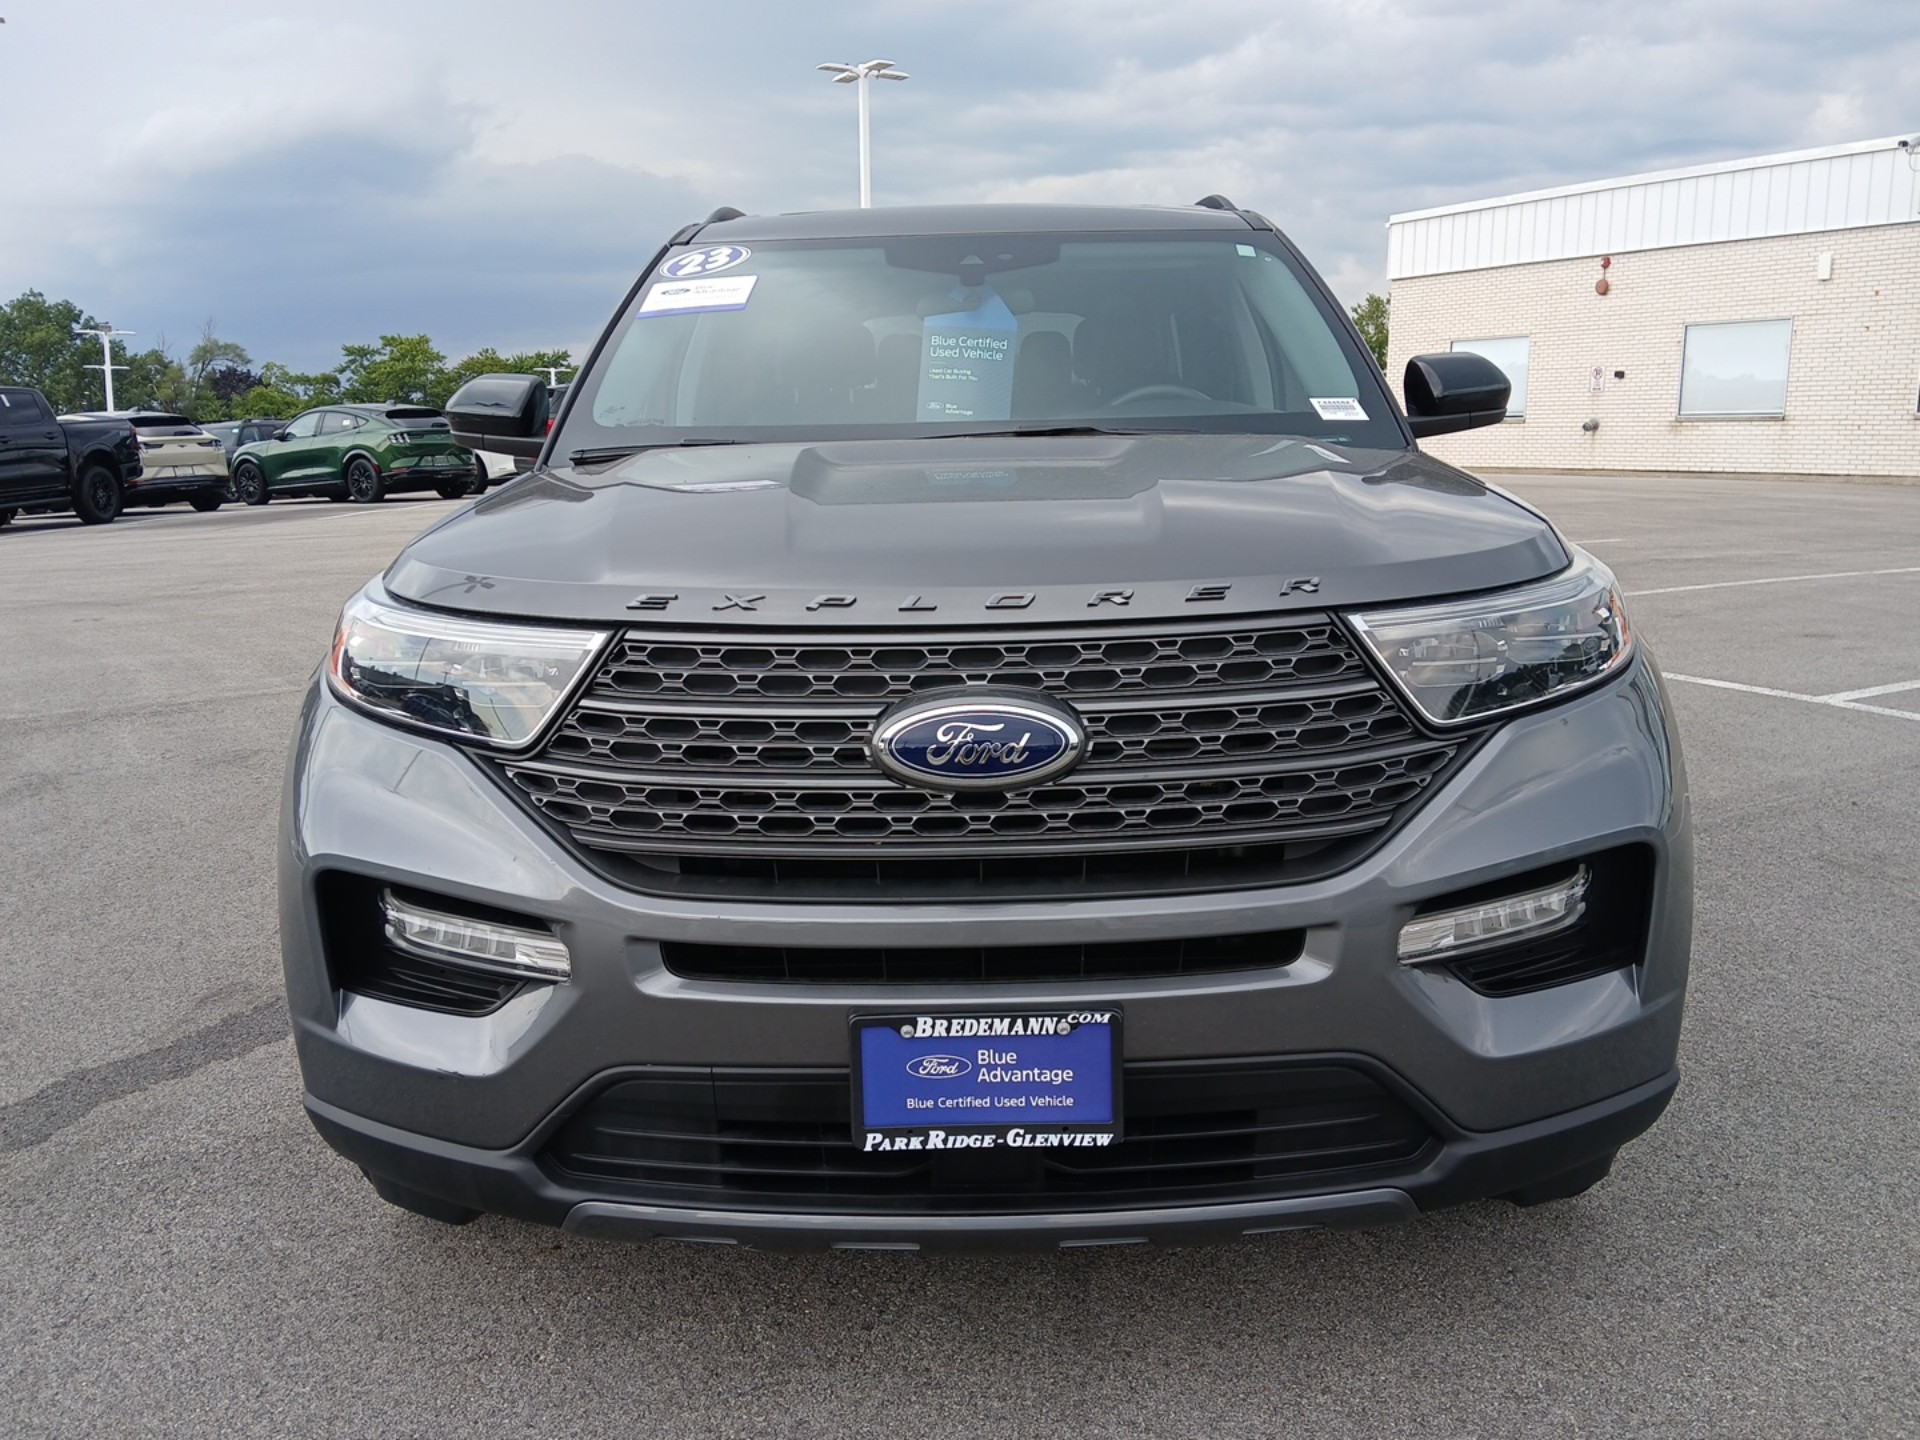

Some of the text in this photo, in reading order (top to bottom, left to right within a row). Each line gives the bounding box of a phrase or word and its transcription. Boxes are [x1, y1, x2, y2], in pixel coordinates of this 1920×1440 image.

[676, 247, 733, 276] 23
[931, 335, 1008, 350] Blue Certified
[930, 346, 1004, 361] Used Vehicle
[626, 576, 1321, 612] EXPLORER
[926, 722, 1031, 766] Ford
[977, 1049, 1017, 1065] Blue
[918, 1058, 959, 1075] Ford
[977, 1067, 1074, 1085] Advantage
[906, 1094, 1074, 1109] Blue Certified Used Vehicle
[863, 1132, 924, 1151] PARK
